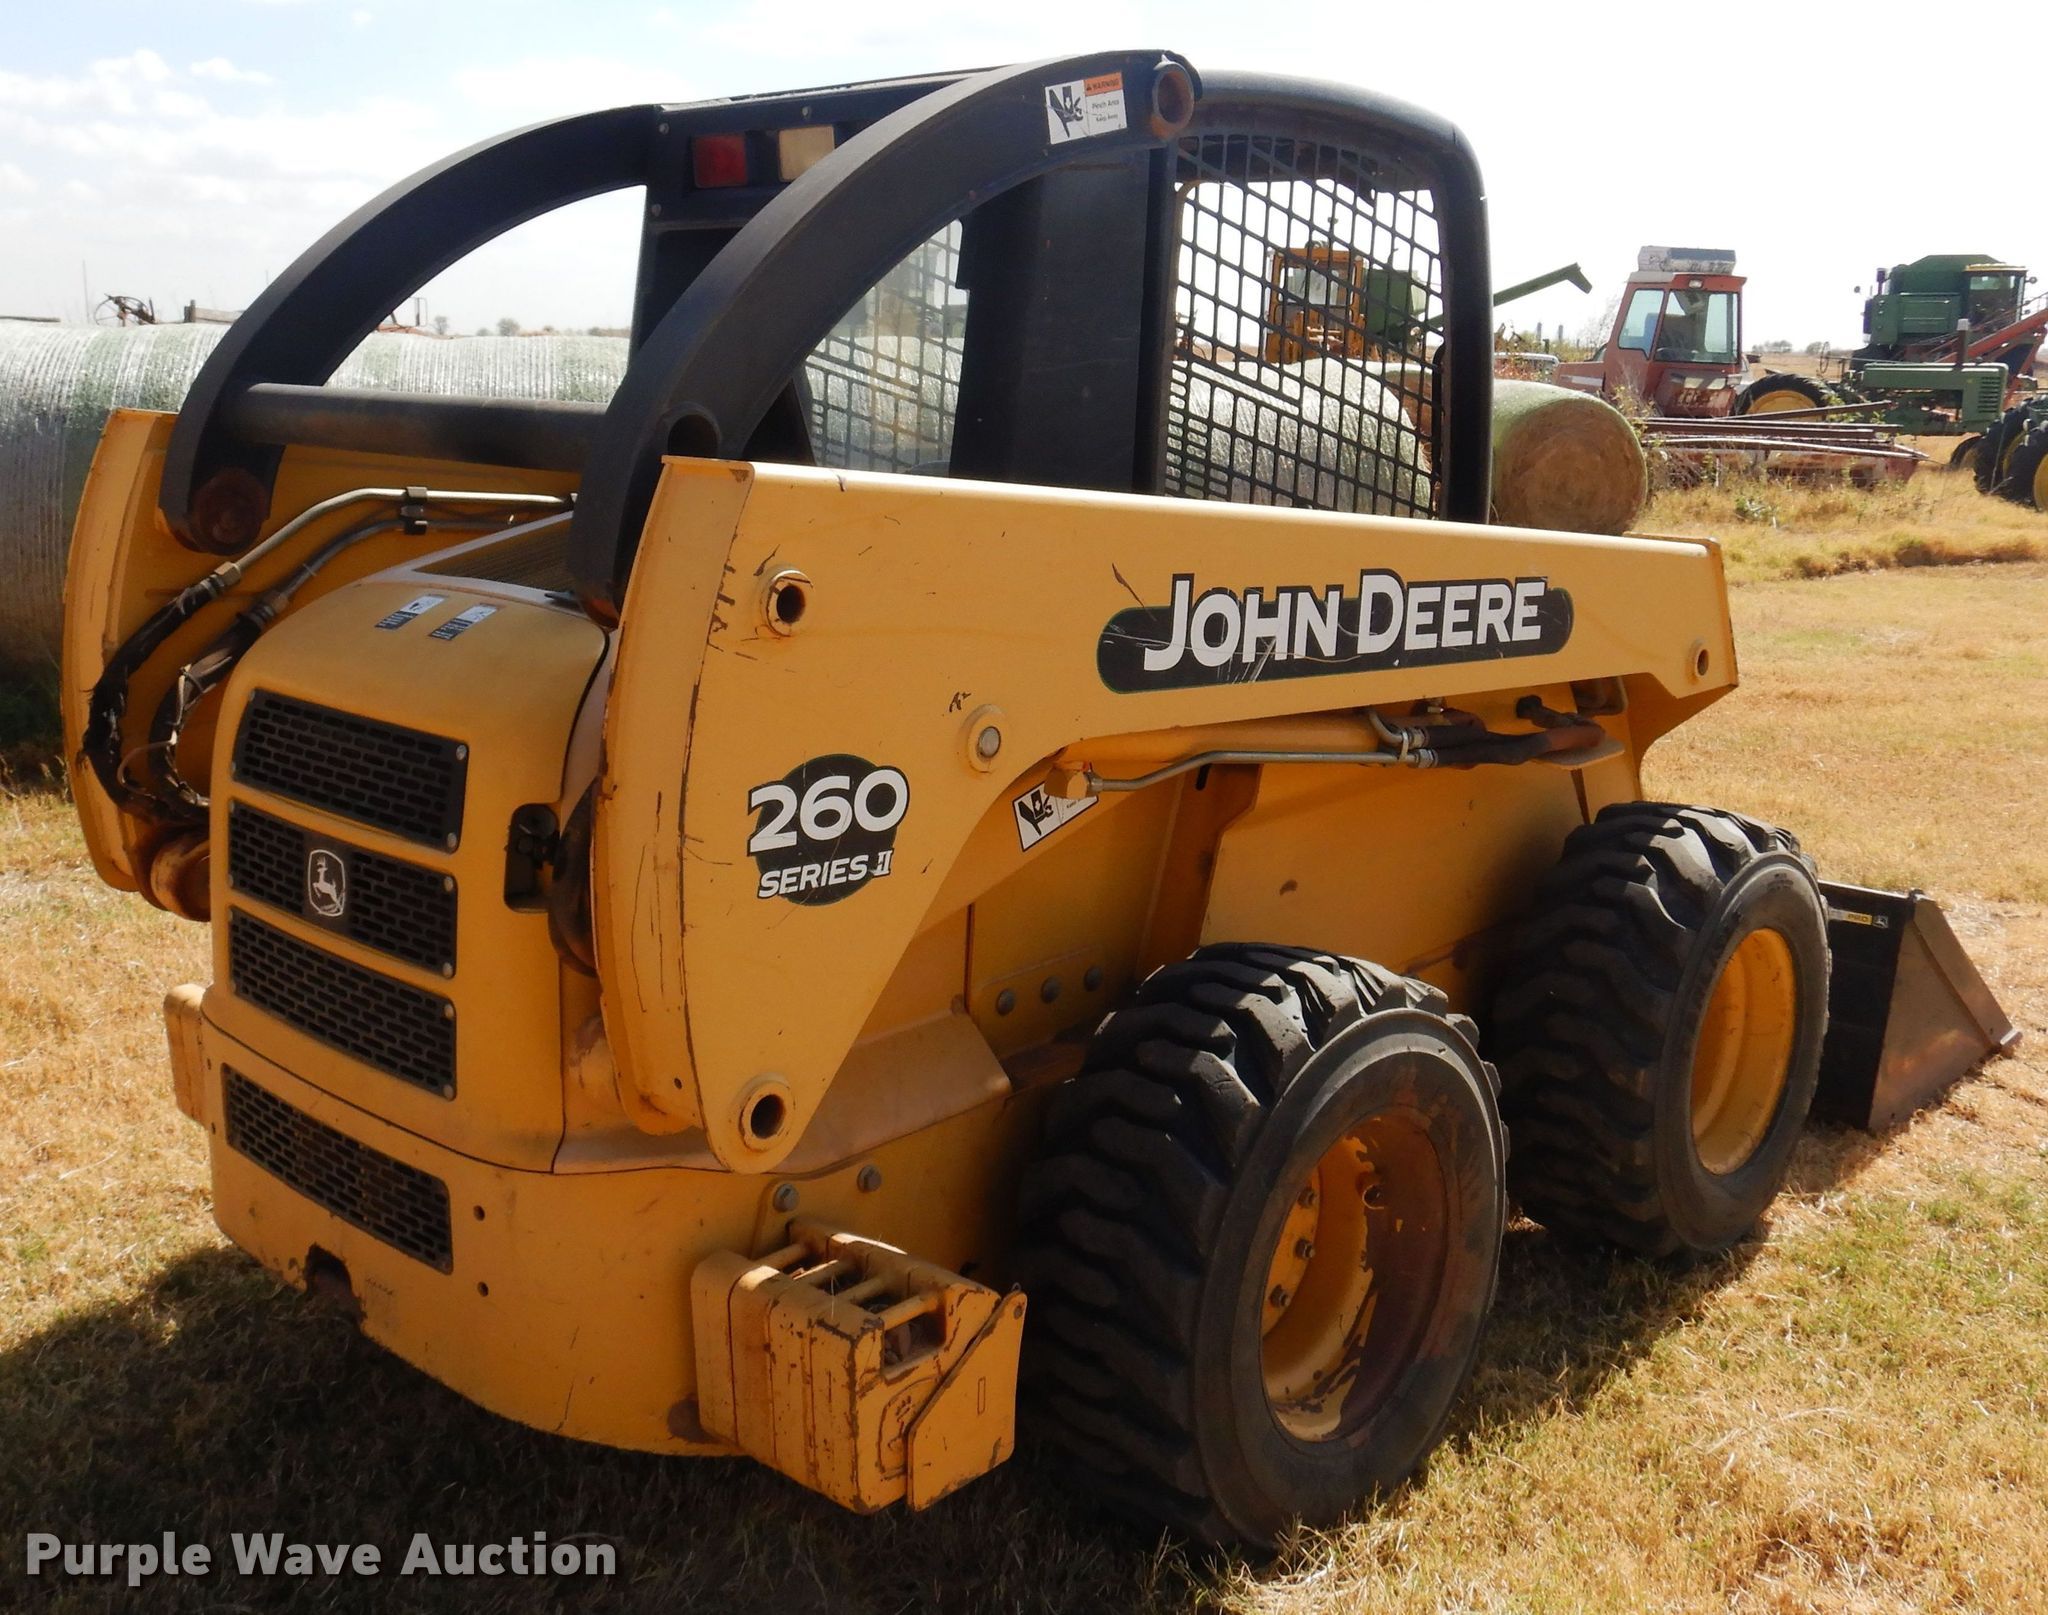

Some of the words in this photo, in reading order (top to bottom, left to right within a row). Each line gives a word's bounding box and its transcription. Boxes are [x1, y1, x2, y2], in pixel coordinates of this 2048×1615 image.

[1143, 579, 1340, 672] JOHN
[1357, 573, 1546, 655] DEERE
[750, 769, 908, 853] 260
[758, 854, 870, 898] SERIES
